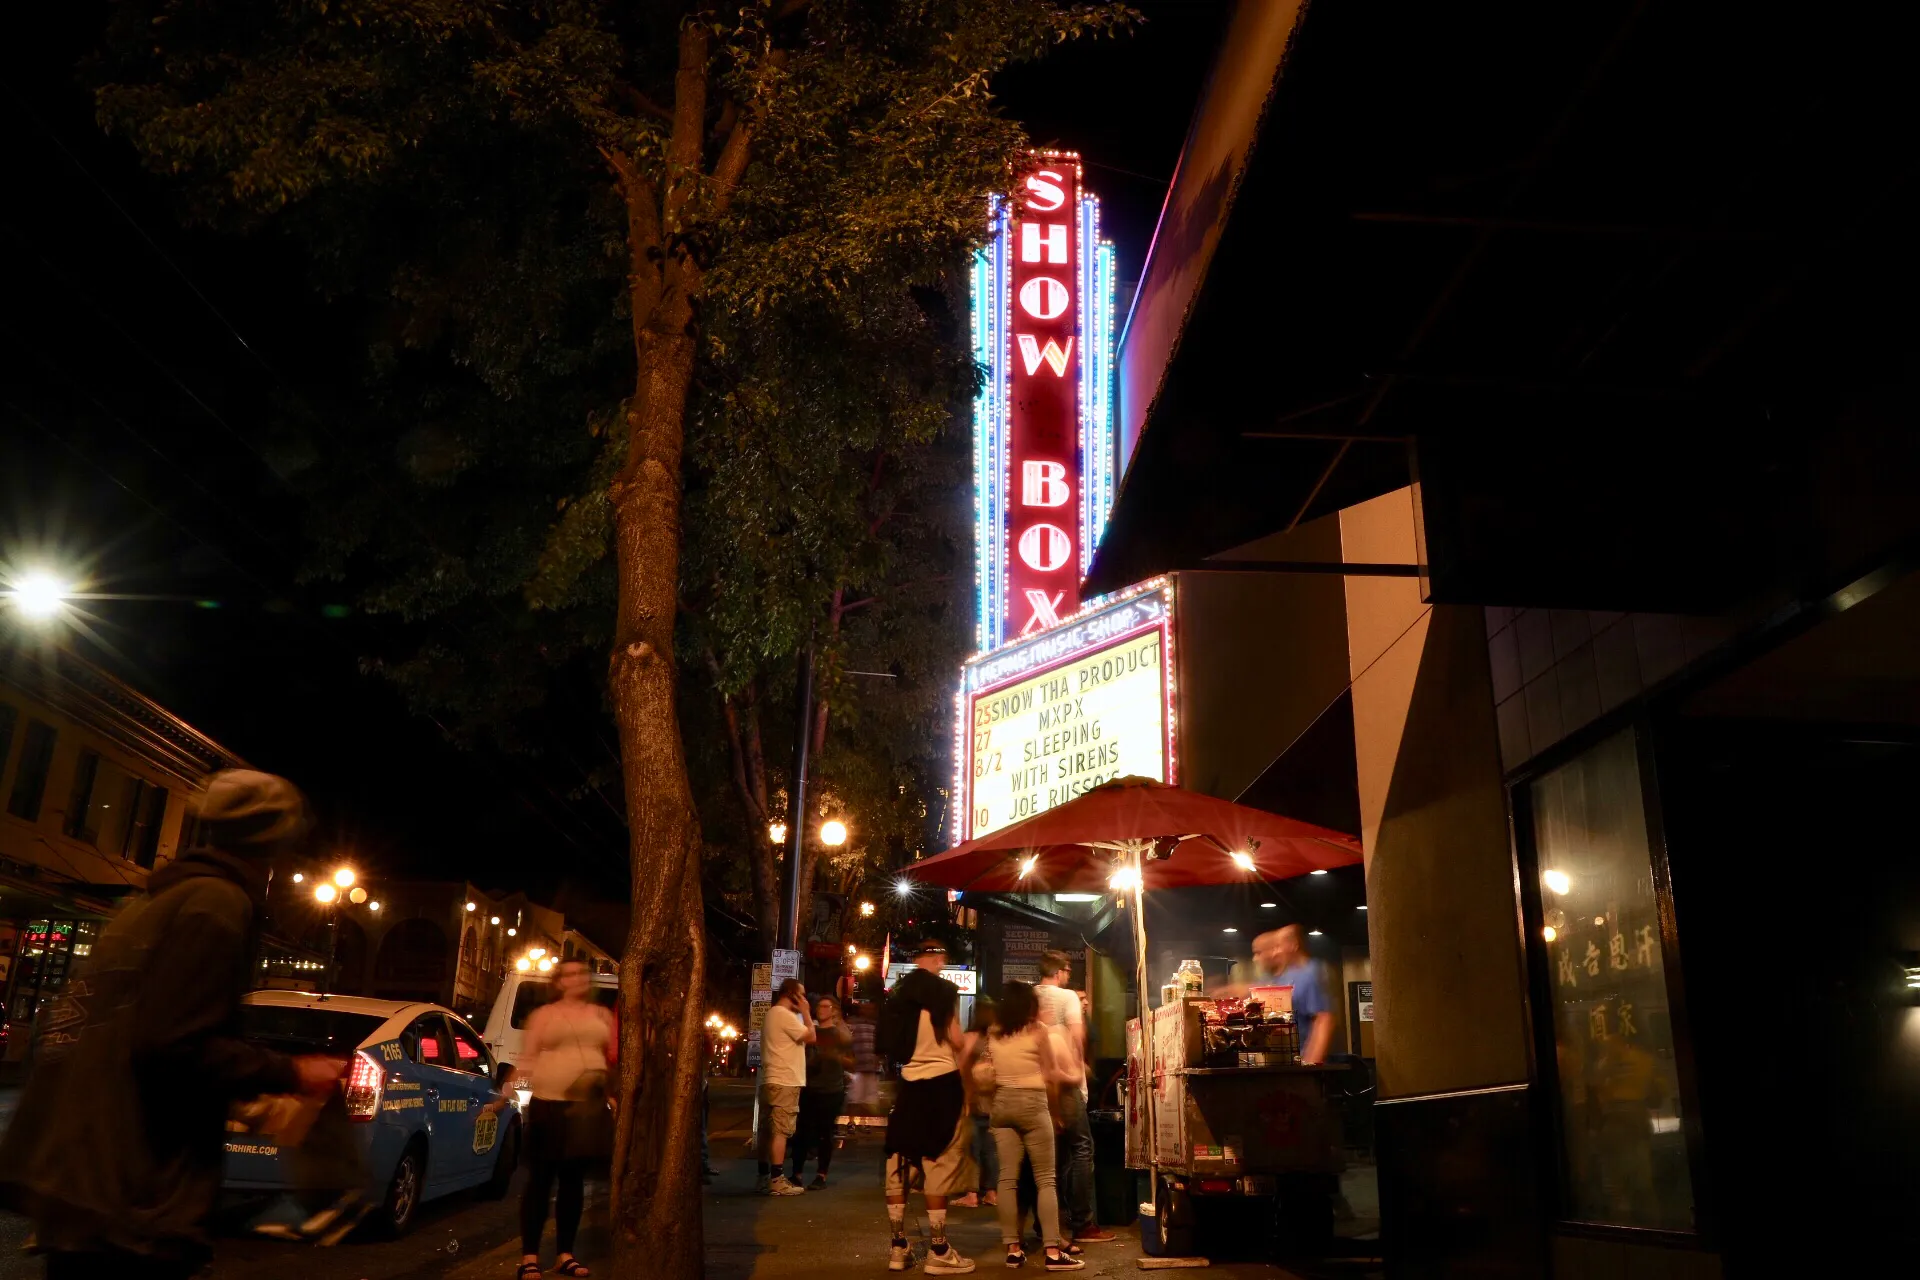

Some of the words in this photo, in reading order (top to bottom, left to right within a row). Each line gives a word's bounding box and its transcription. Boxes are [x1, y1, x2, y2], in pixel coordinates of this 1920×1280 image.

[1016, 170, 1075, 377] SHOW
[1018, 460, 1071, 635] BOX
[1088, 607, 1135, 643] SHOP
[976, 704, 991, 727] 25
[992, 687, 1033, 722] SNOW
[1040, 677, 1070, 701] THA
[1079, 641, 1159, 692] PRODUCT
[975, 752, 1002, 778] 8/2
[1024, 719, 1102, 763] SLEEPING
[976, 730, 991, 753] 27
[1038, 696, 1084, 732] MXPX
[1011, 763, 1048, 793] WITH
[1058, 741, 1119, 779] SIRENS
[974, 808, 989, 829] 10
[1009, 793, 1038, 820] JOE
[1005, 942, 1048, 953] PARKING
[381, 1043, 403, 1061] 2165
